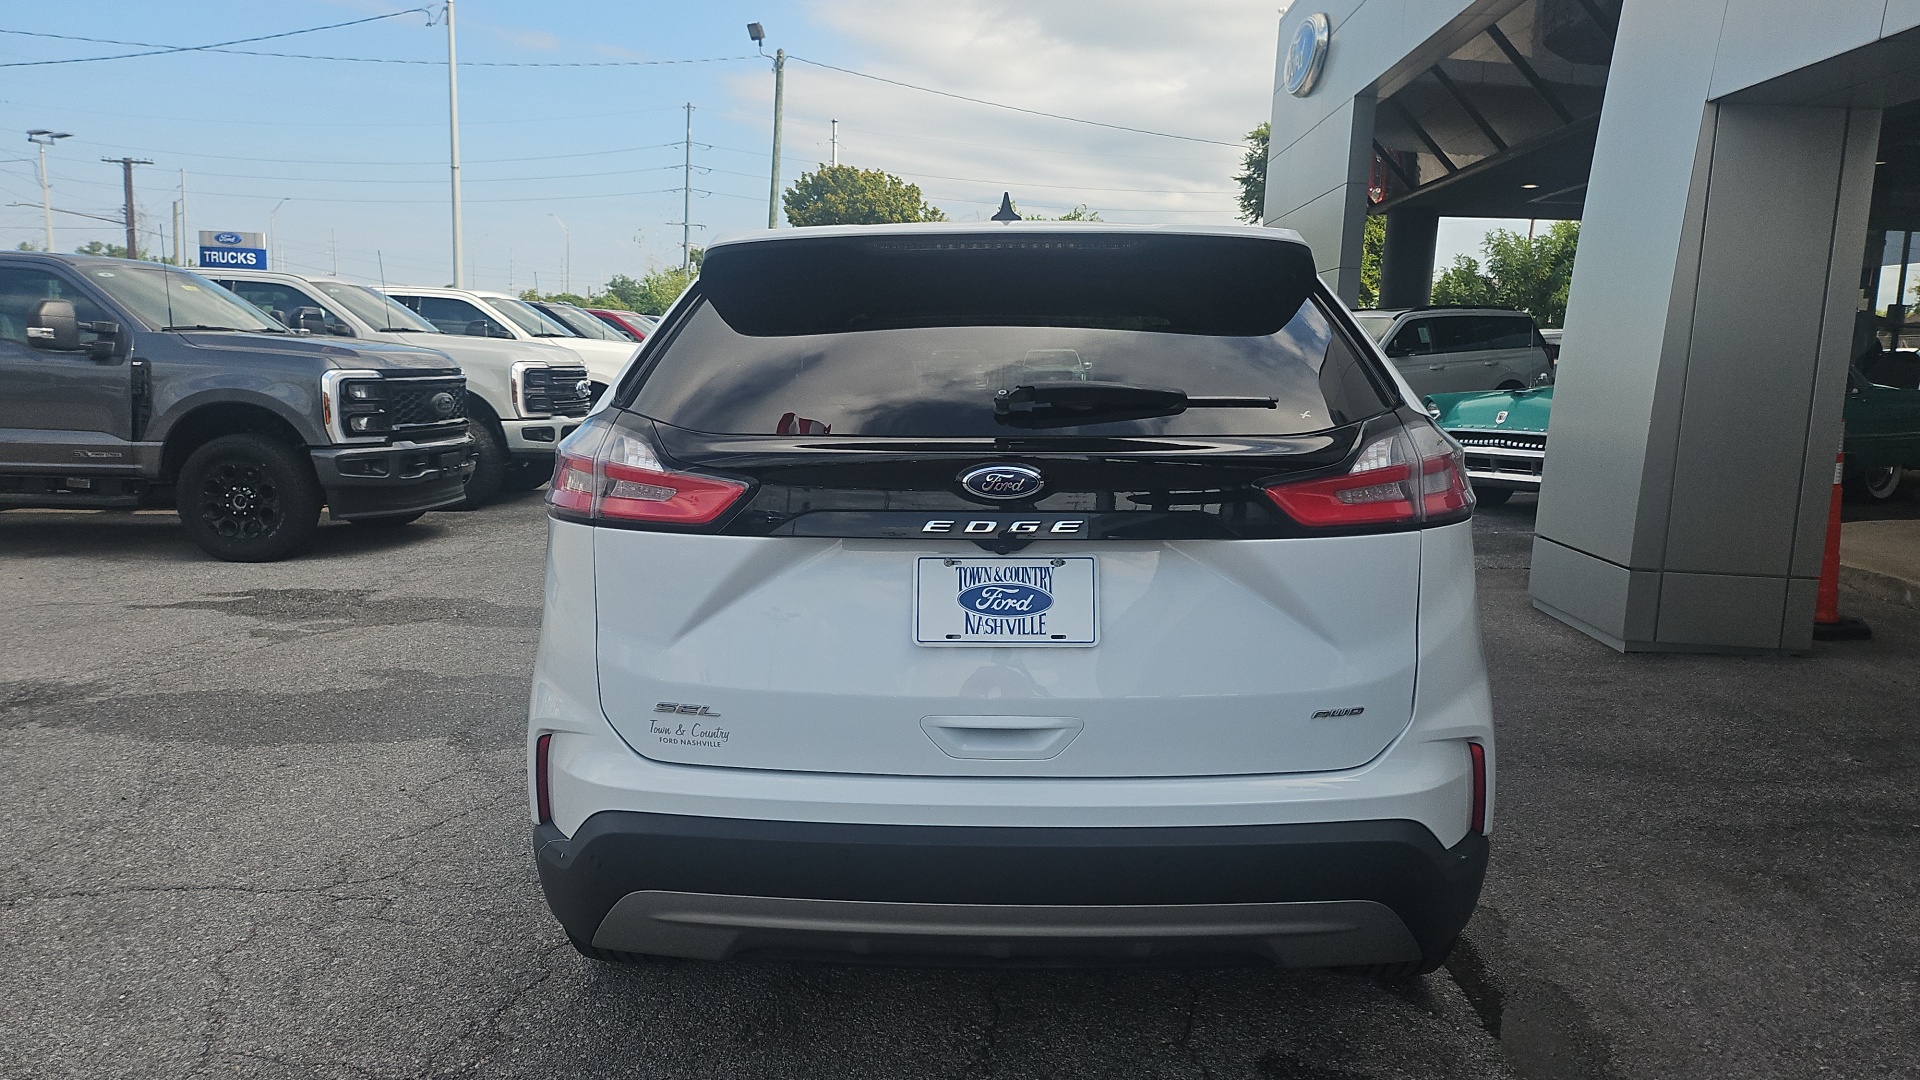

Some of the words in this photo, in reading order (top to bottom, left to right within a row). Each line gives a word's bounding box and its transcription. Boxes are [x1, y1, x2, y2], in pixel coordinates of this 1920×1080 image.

[218, 234, 236, 242] Ford
[203, 251, 257, 265] TRUCKS
[981, 473, 1024, 492] Ford
[921, 520, 1084, 534] EDGE
[956, 566, 992, 591] TOWN
[993, 566, 1005, 583] &
[1004, 566, 1055, 594] COUNTRY
[975, 586, 1035, 611] Ford
[964, 611, 1047, 635] NASHVILLE
[653, 702, 721, 717] SEL
[1311, 707, 1365, 719] AWD
[649, 719, 671, 734] Town
[675, 723, 686, 736] &
[691, 722, 730, 743] Country
[680, 739, 721, 748] NASHVILLE
